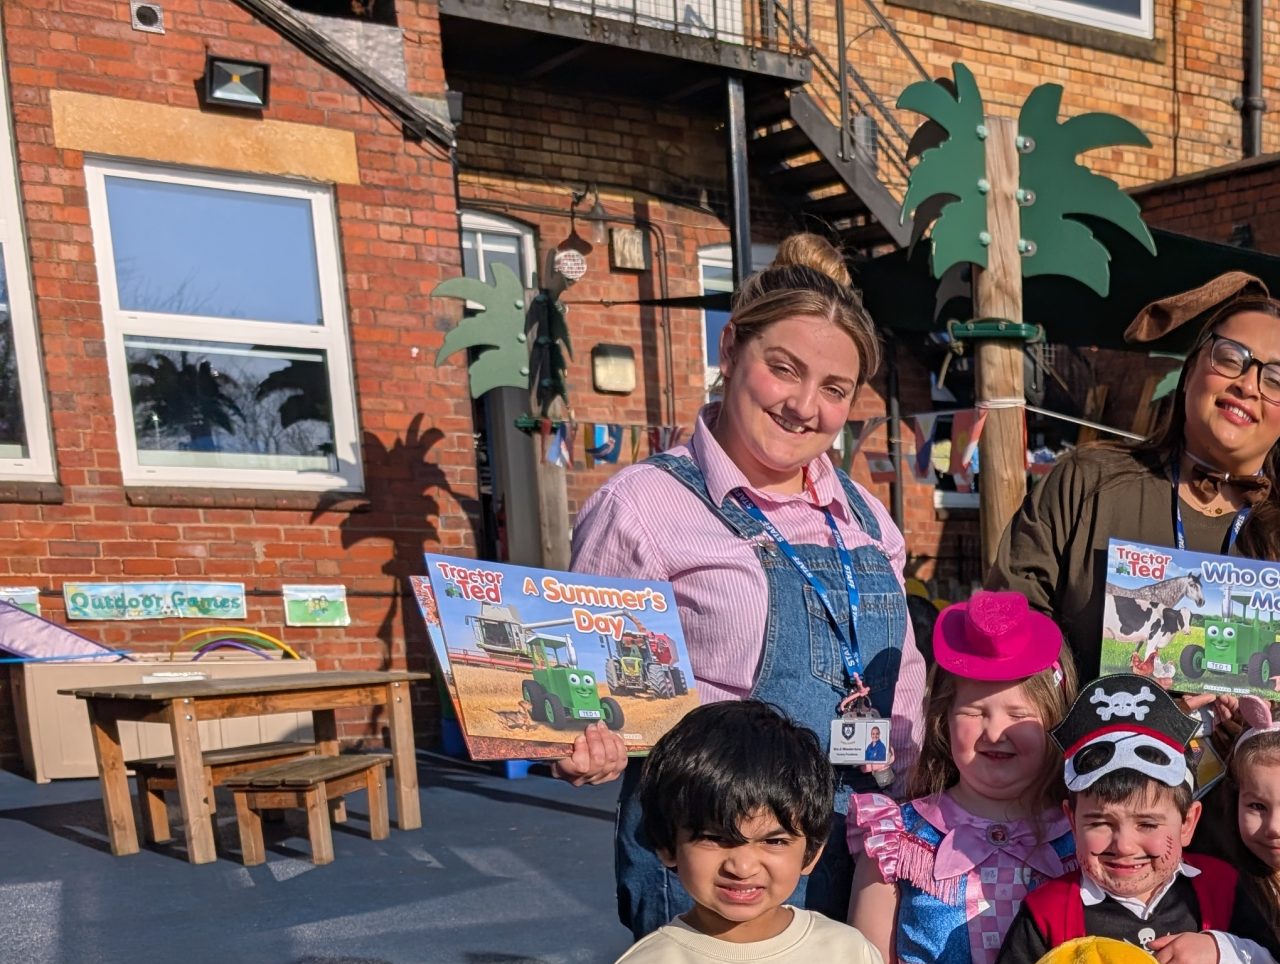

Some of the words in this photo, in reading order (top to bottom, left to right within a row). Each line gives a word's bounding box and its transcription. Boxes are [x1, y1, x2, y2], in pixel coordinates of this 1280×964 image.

[762, 520, 784, 542] STAFF
[791, 556, 813, 578] STAFF
[1116, 547, 1171, 566] Tractor
[437, 562, 503, 585] Tractor
[844, 564, 856, 589] STAFF
[1128, 560, 1167, 582] Ted
[1201, 561, 1256, 587] Who
[70, 592, 163, 611] Outdoor
[171, 590, 241, 614] Games
[457, 579, 502, 603] Ted
[523, 578, 537, 595] A
[542, 576, 668, 612] Summer's
[572, 608, 624, 640] Day
